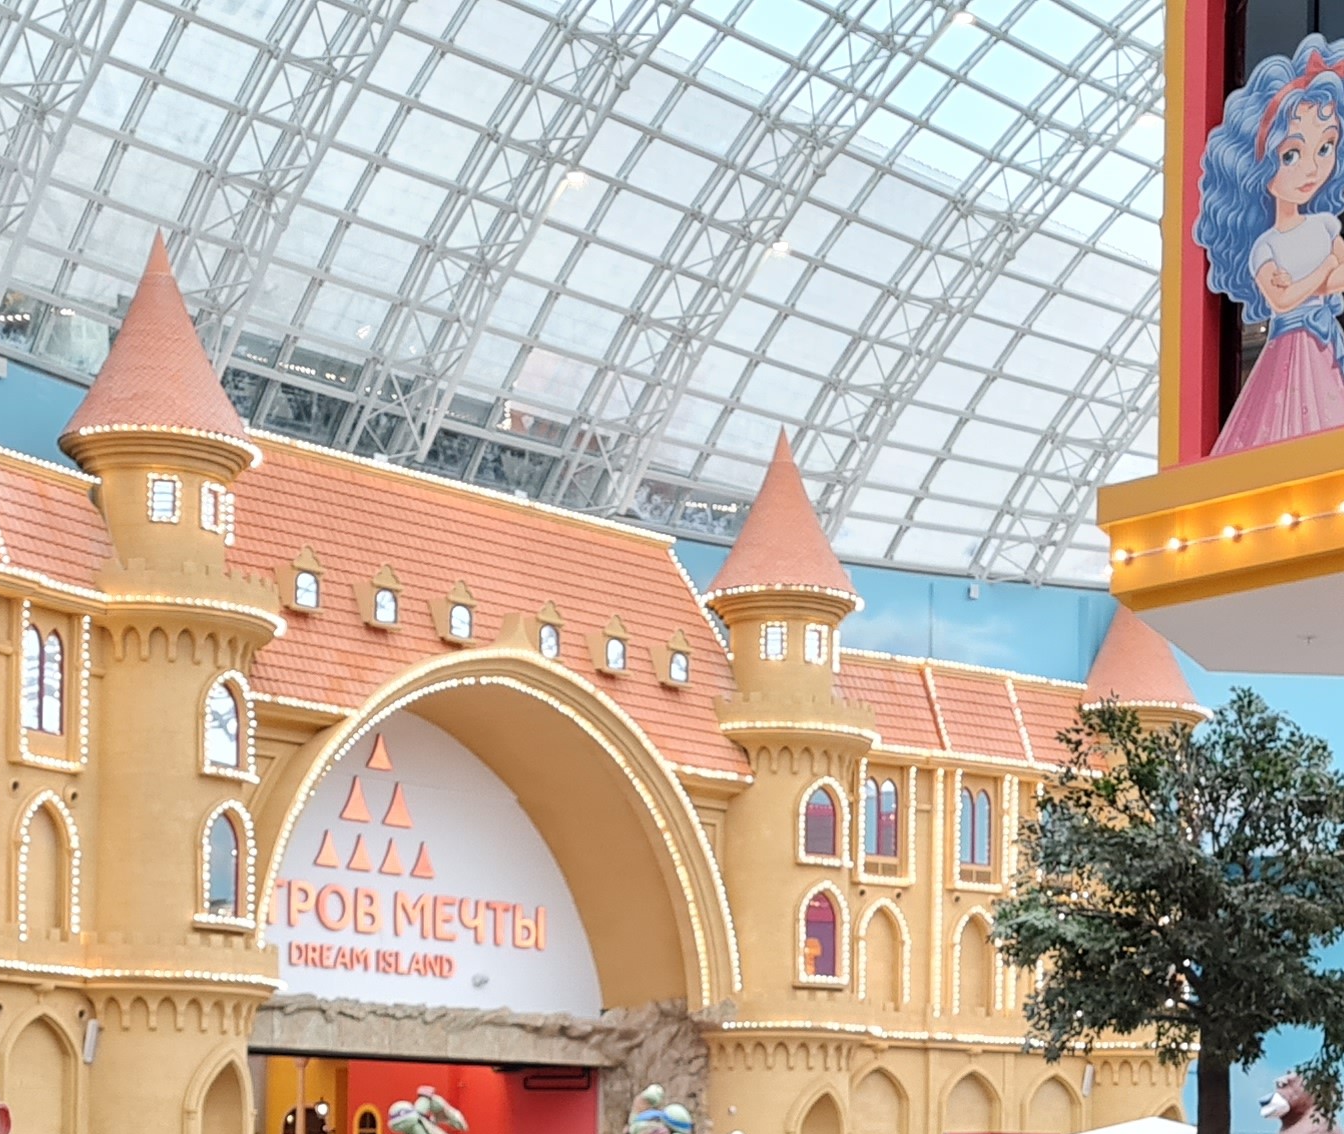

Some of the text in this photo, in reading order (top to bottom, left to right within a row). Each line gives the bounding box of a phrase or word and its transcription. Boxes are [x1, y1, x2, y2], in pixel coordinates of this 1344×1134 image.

[394, 890, 546, 950] МЕЧТЫ
[289, 941, 456, 978] DREAM ISLAND
